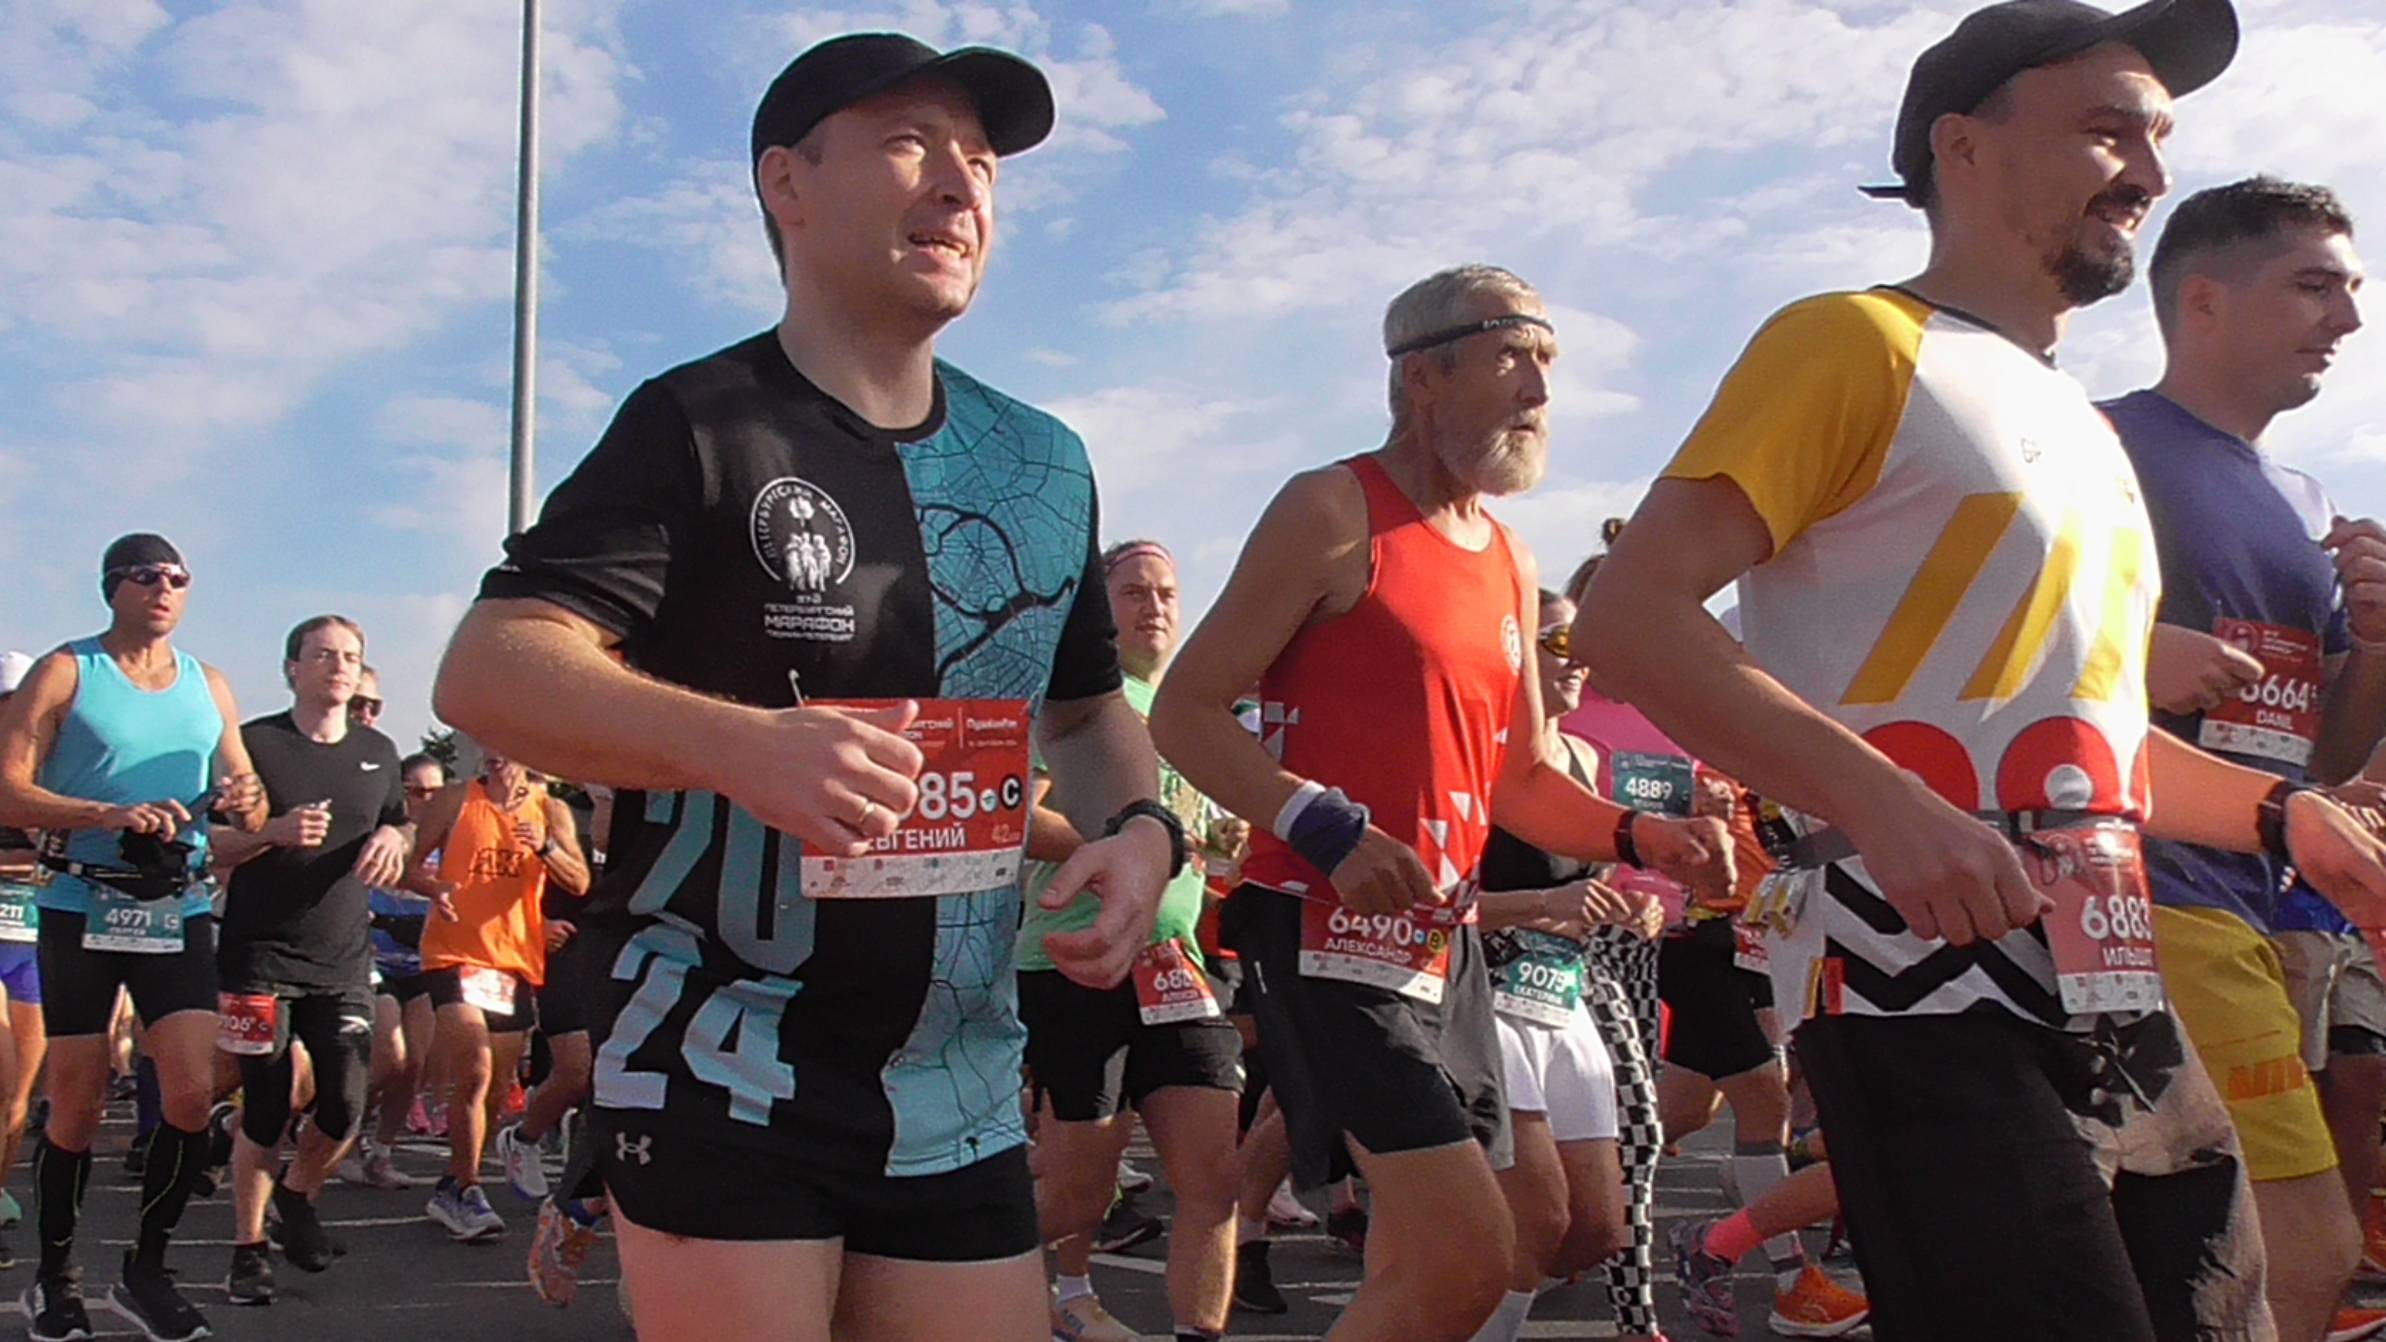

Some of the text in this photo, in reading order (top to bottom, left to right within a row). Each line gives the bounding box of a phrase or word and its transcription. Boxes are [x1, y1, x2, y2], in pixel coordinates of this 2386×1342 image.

[764, 614, 855, 633] МАРАФОН
[897, 771, 1021, 821] 85 C
[1625, 777, 1674, 801] 4889
[867, 821, 967, 851] ВГЕНИЙ
[628, 784, 818, 975] 20
[105, 908, 152, 928] 4971
[1328, 906, 1413, 946] 6490
[594, 916, 803, 1127] 24
